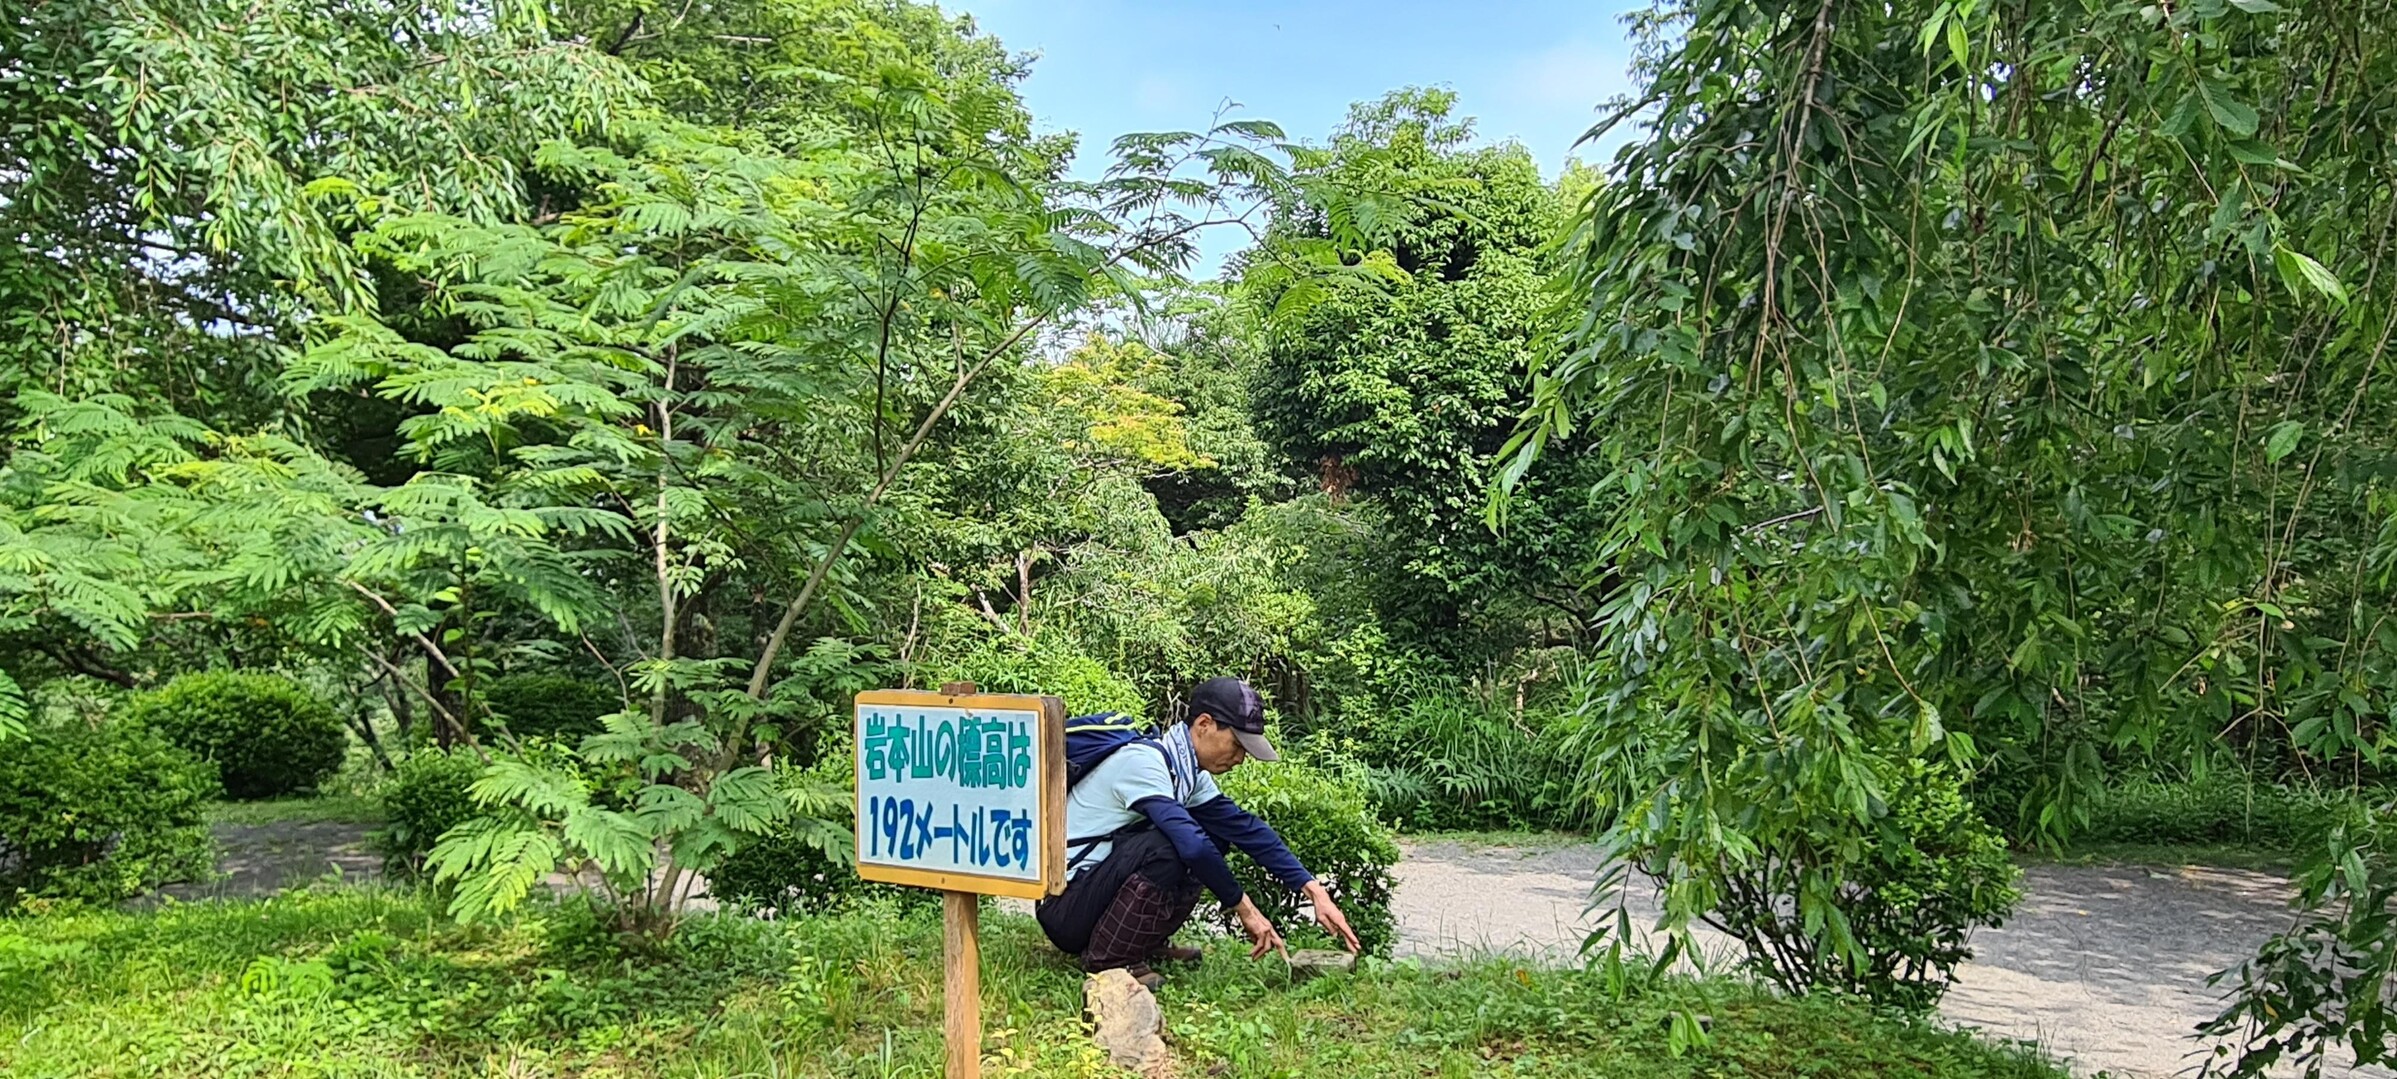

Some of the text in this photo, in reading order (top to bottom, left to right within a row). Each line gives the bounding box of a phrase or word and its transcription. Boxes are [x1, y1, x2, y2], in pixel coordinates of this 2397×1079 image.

[865, 713, 1031, 790] 岩本山の標高は
[870, 796, 1032, 871] 192メートルです
